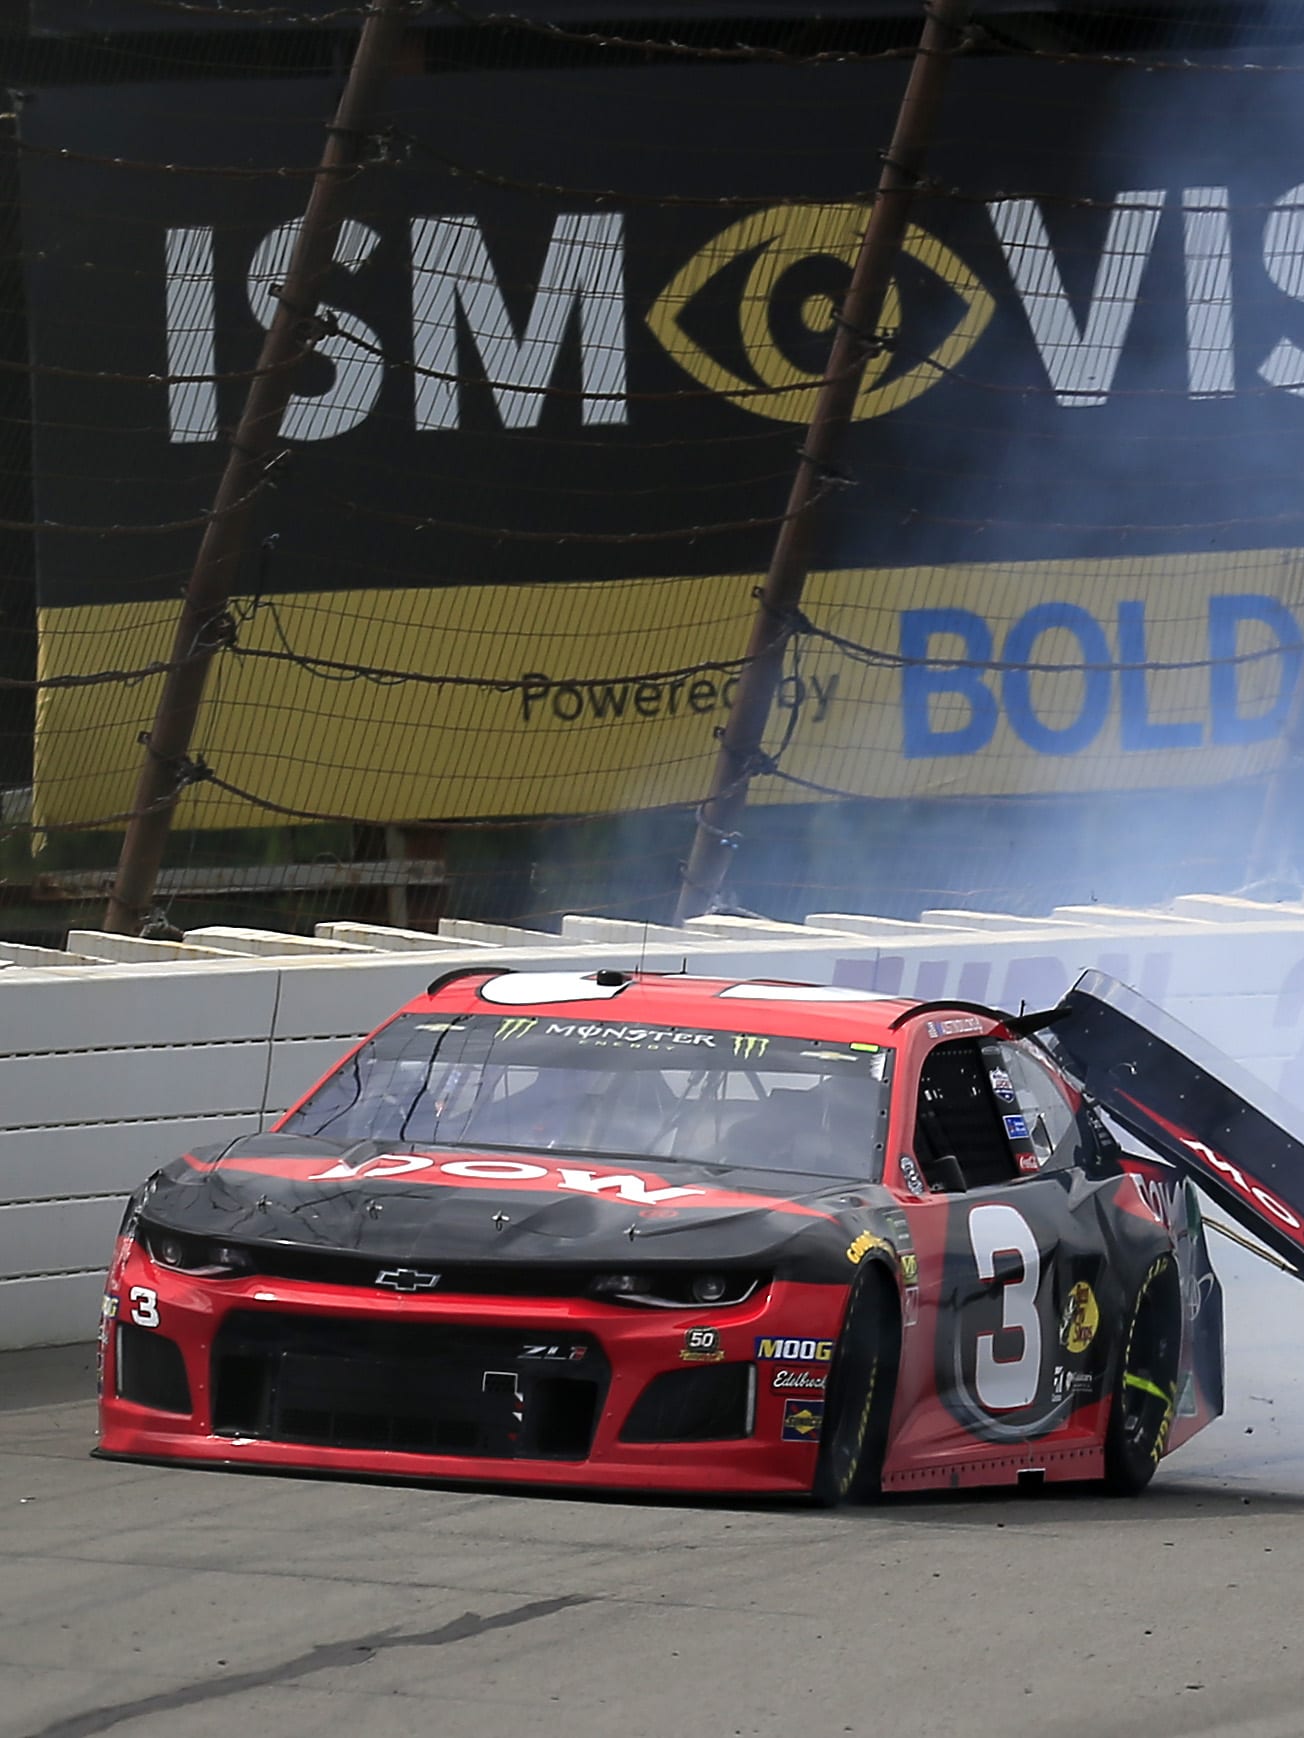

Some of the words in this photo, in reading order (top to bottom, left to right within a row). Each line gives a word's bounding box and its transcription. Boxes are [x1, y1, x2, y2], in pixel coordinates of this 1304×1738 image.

[164, 213, 629, 443] ISM
[544, 1023, 717, 1048] MONSTER
[307, 1153, 706, 1206] DOW
[129, 1285, 161, 1329] 3
[966, 1203, 1043, 1409] 3
[689, 1332, 715, 1348] 50
[757, 1338, 833, 1361] MOOG
